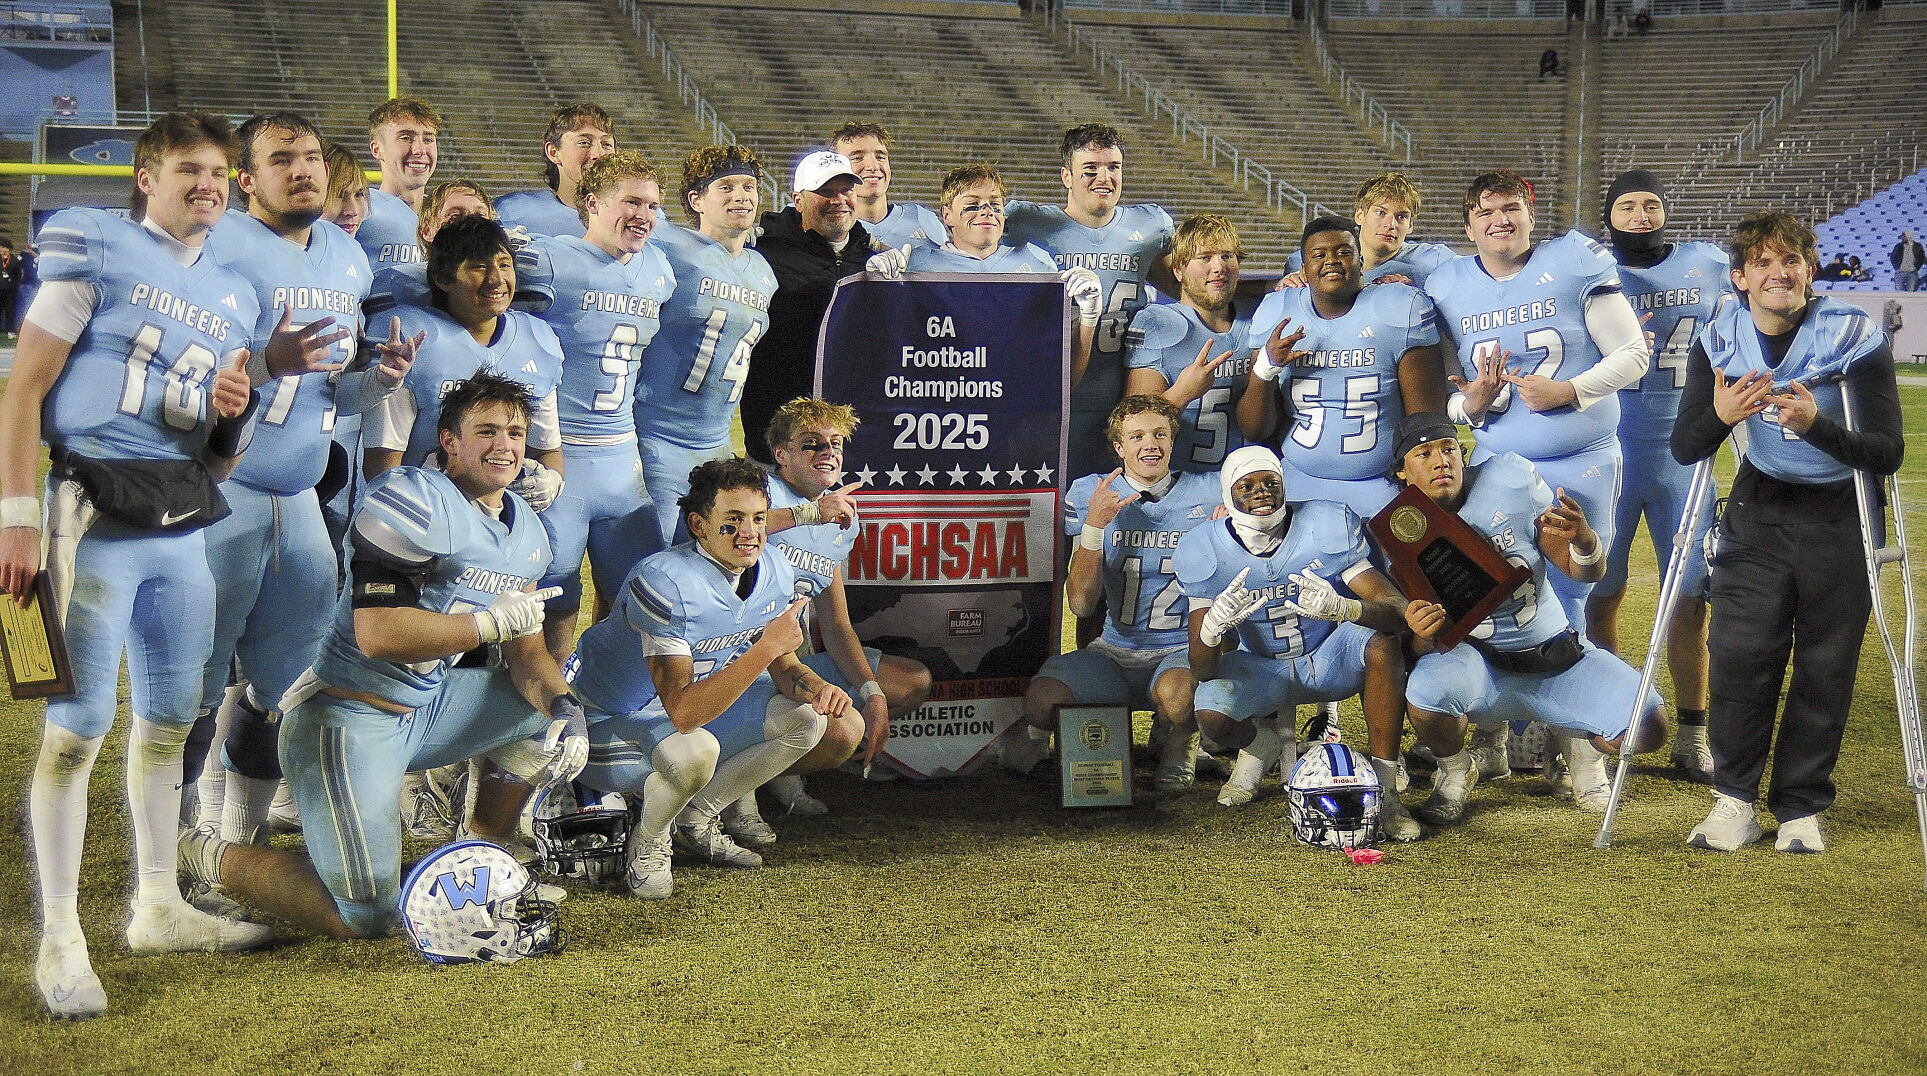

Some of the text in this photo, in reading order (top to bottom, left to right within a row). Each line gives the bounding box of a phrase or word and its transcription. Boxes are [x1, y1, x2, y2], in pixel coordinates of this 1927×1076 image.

[1054, 252, 1140, 272] PIONEERS
[130, 282, 232, 342] PIONEERS
[273, 286, 354, 315] PIONEERS
[1461, 297, 1557, 335] PIONEERS
[1628, 287, 1700, 311] ONEERS
[926, 316, 956, 338] 6A
[591, 322, 639, 413] 9
[683, 306, 763, 404] 14
[901, 346, 987, 368] Football
[884, 376, 1003, 402] Champions
[893, 413, 990, 450] 2025
[1290, 373, 1382, 455] 55
[848, 521, 1029, 581] NCHSAA
[1119, 554, 1184, 633] 12
[950, 620, 982, 628] BUREAU
[960, 612, 982, 620] FARM
[1265, 605, 1305, 660] 3
[889, 720, 995, 740] SSOCIATION
[437, 866, 490, 911] W
